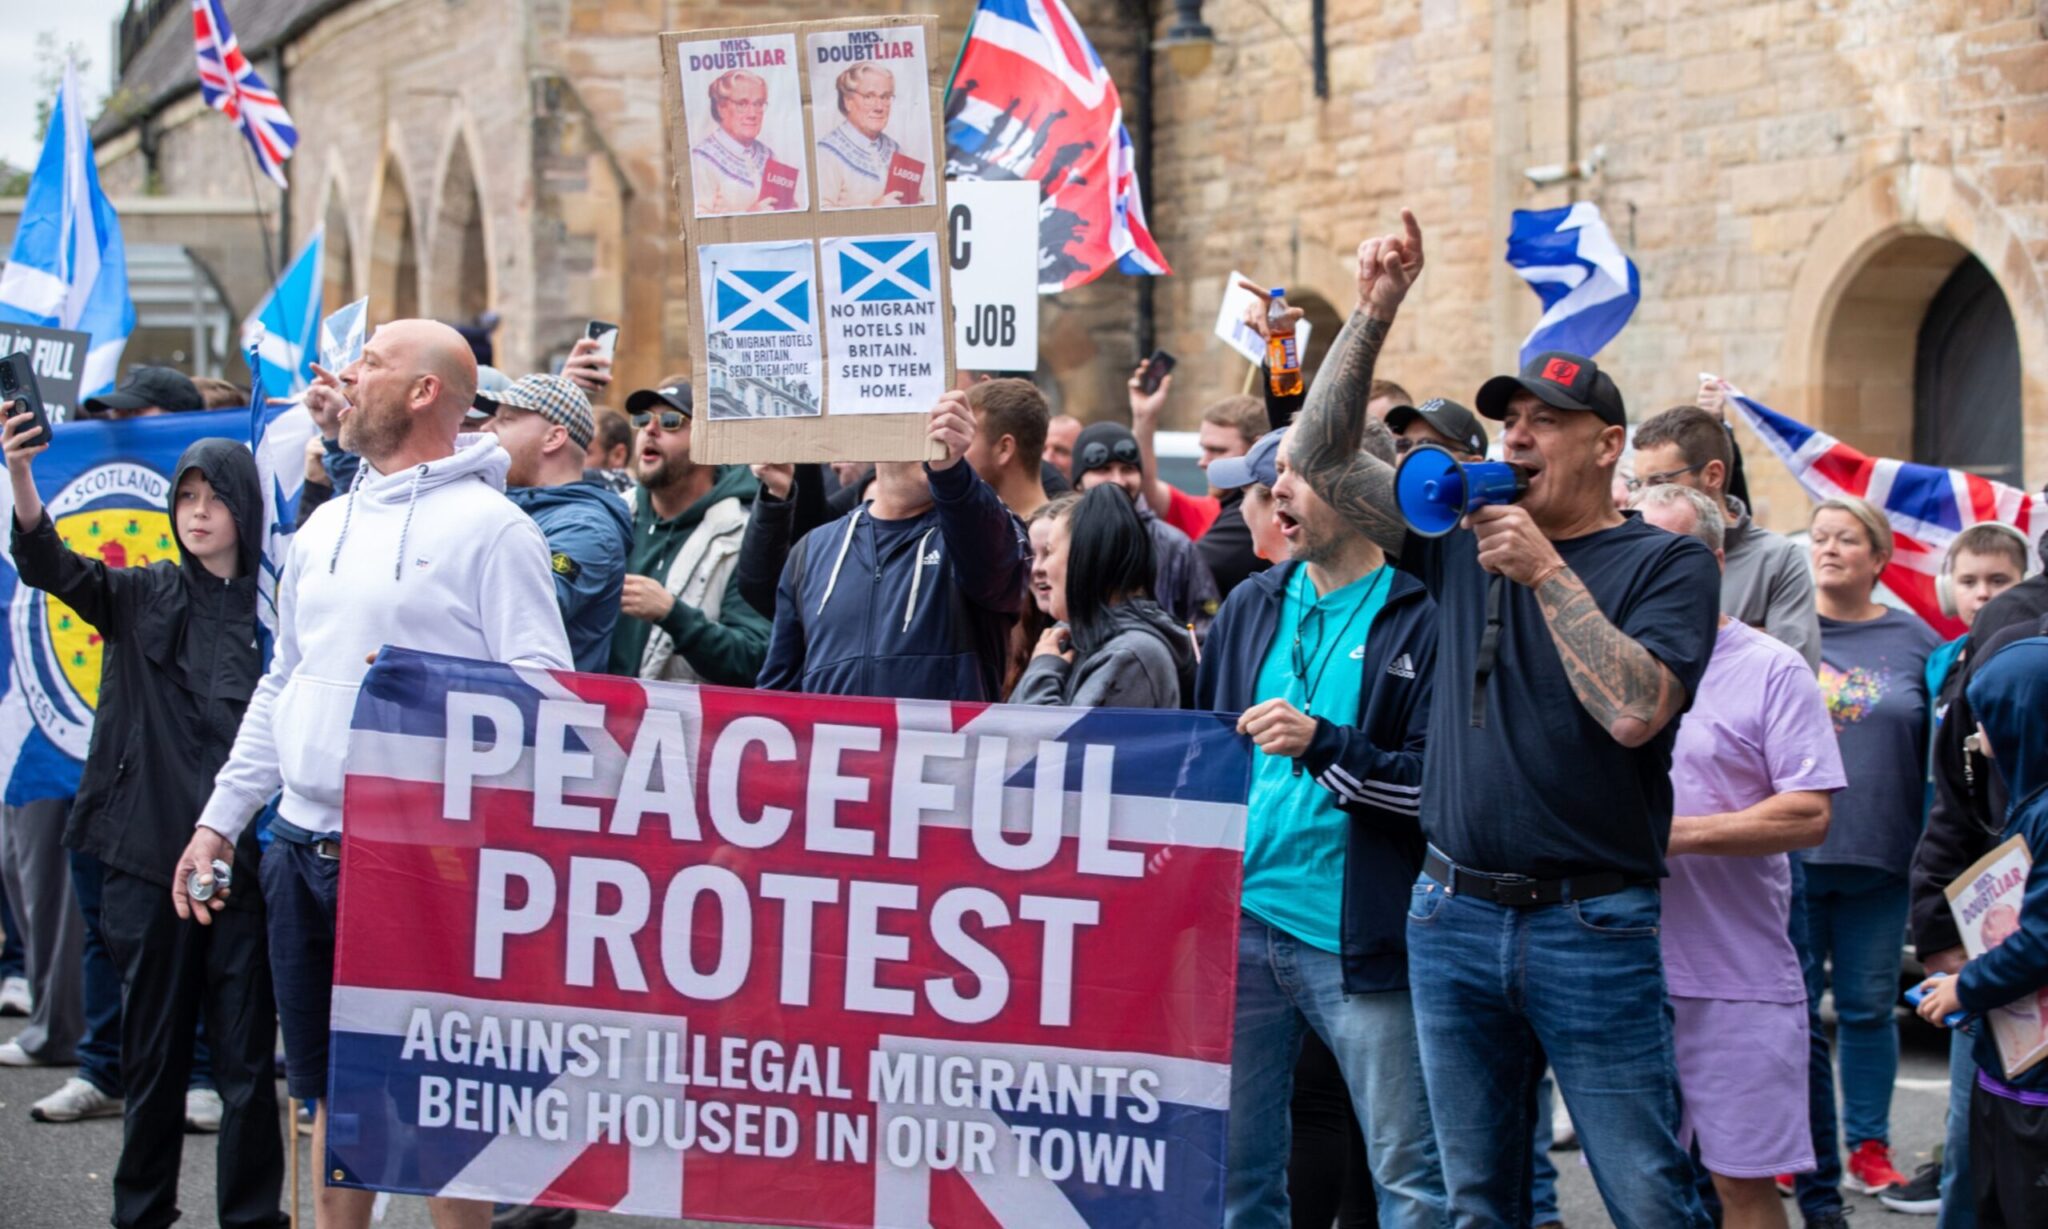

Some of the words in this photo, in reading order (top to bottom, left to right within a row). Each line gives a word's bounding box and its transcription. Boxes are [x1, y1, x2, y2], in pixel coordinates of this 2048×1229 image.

[690, 49, 786, 71] DOUBTLIAR
[817, 41, 914, 63] DOUBTLIAR
[831, 304, 855, 318] NO
[861, 301, 935, 317] MIGRANT
[843, 323, 903, 338] HOTELS
[909, 322, 926, 336] IN
[965, 304, 1016, 347] JOB
[721, 338, 734, 350] NO
[736, 335, 776, 349] MIGRANT
[779, 334, 813, 347] HOTELS
[849, 343, 917, 358] BRITAIN.
[742, 351, 751, 363] IN
[729, 365, 753, 377] SEND
[756, 364, 780, 376] THEM
[842, 364, 883, 378] SEND
[889, 363, 932, 377] THEM
[860, 384, 912, 398] HOME.
[74, 469, 162, 501] SCOTLAND
[442, 691, 1145, 878] PEACEFUL
[473, 847, 1100, 1027] PROTEST
[401, 1007, 631, 1080] AGAINST
[645, 1031, 852, 1100] ILLEGAL
[868, 1050, 1161, 1124] MIGRANTS
[418, 1075, 570, 1142] BEING
[586, 1091, 799, 1161] HOUSED
[815, 1111, 869, 1164] IN
[886, 1115, 996, 1175] OUR
[1010, 1125, 1166, 1192] TOWN
